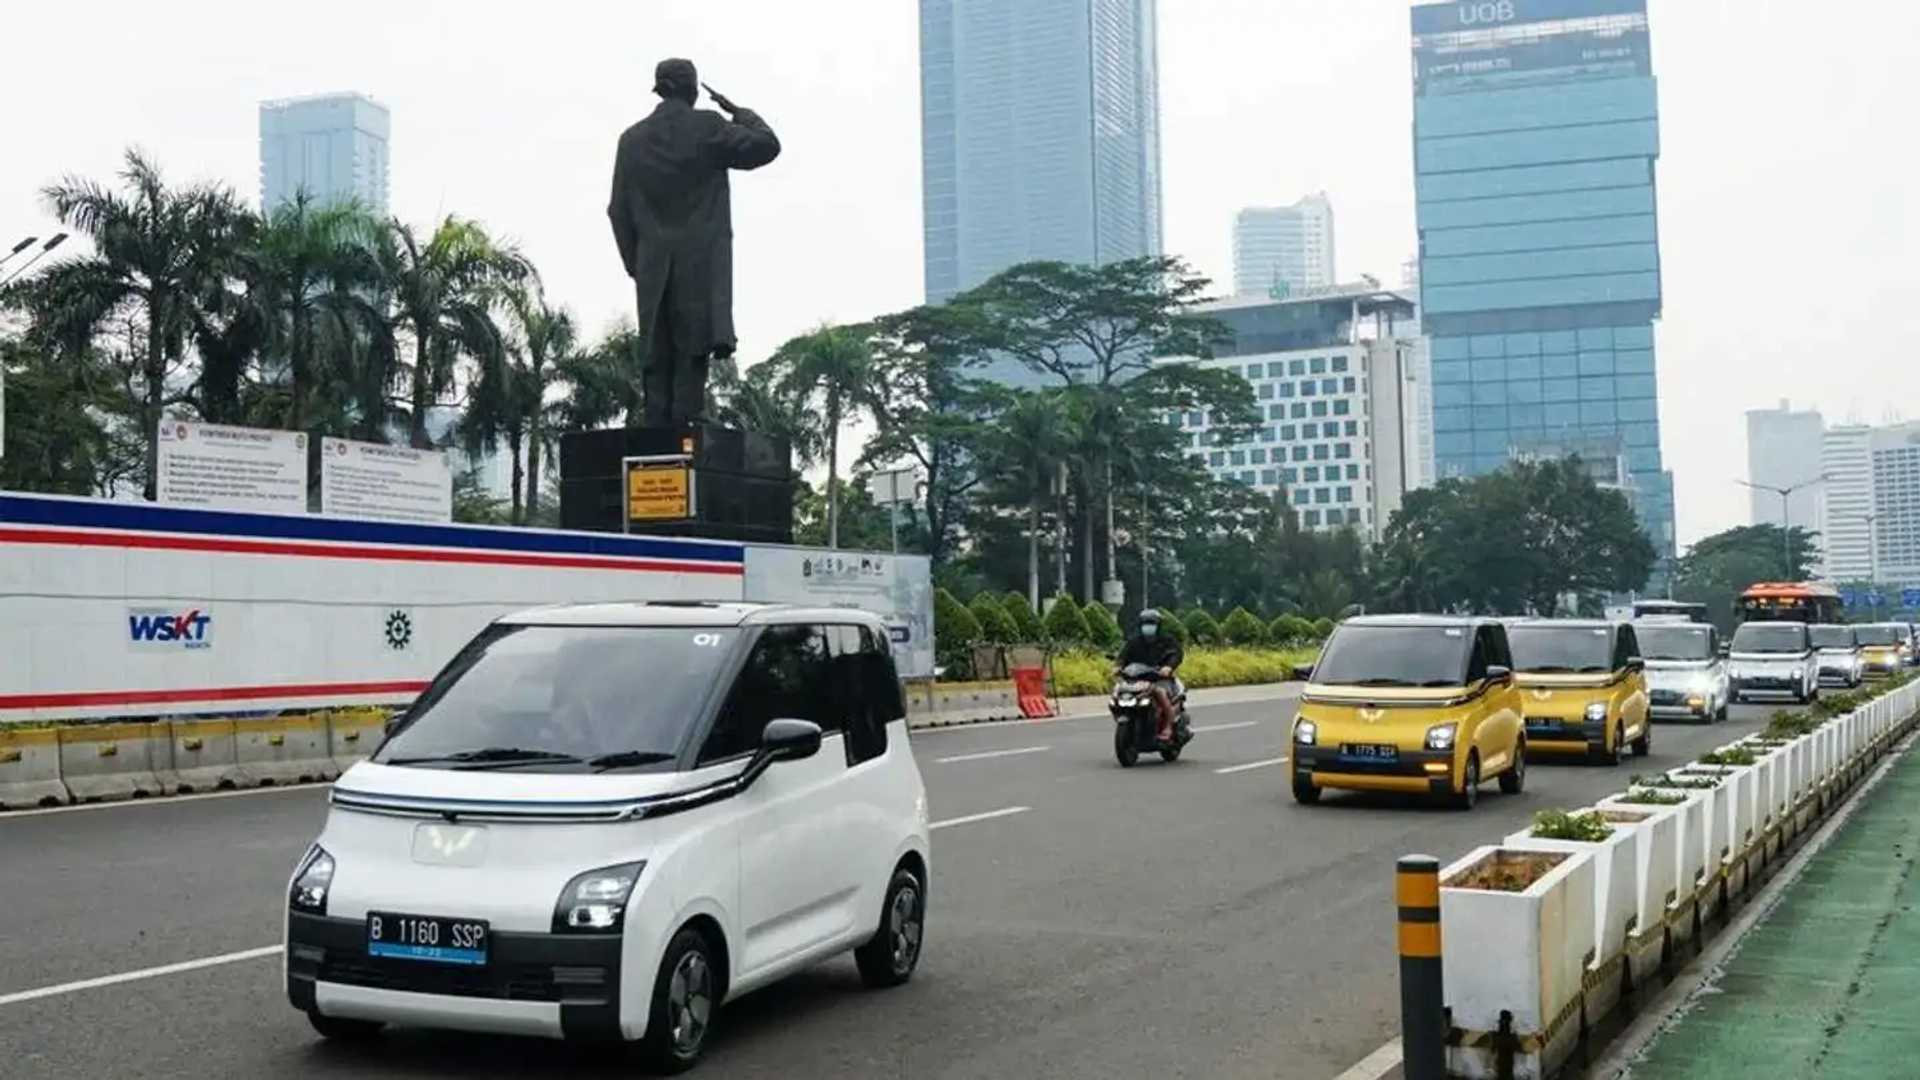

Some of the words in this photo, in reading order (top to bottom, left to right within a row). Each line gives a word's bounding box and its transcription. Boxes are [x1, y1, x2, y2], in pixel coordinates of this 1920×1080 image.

[1459, 0, 1515, 24] UOB
[129, 610, 211, 641] WSKT
[693, 633, 721, 647] 01
[371, 916, 382, 940] B
[400, 919, 439, 945] 1160
[452, 923, 484, 948] SSP
